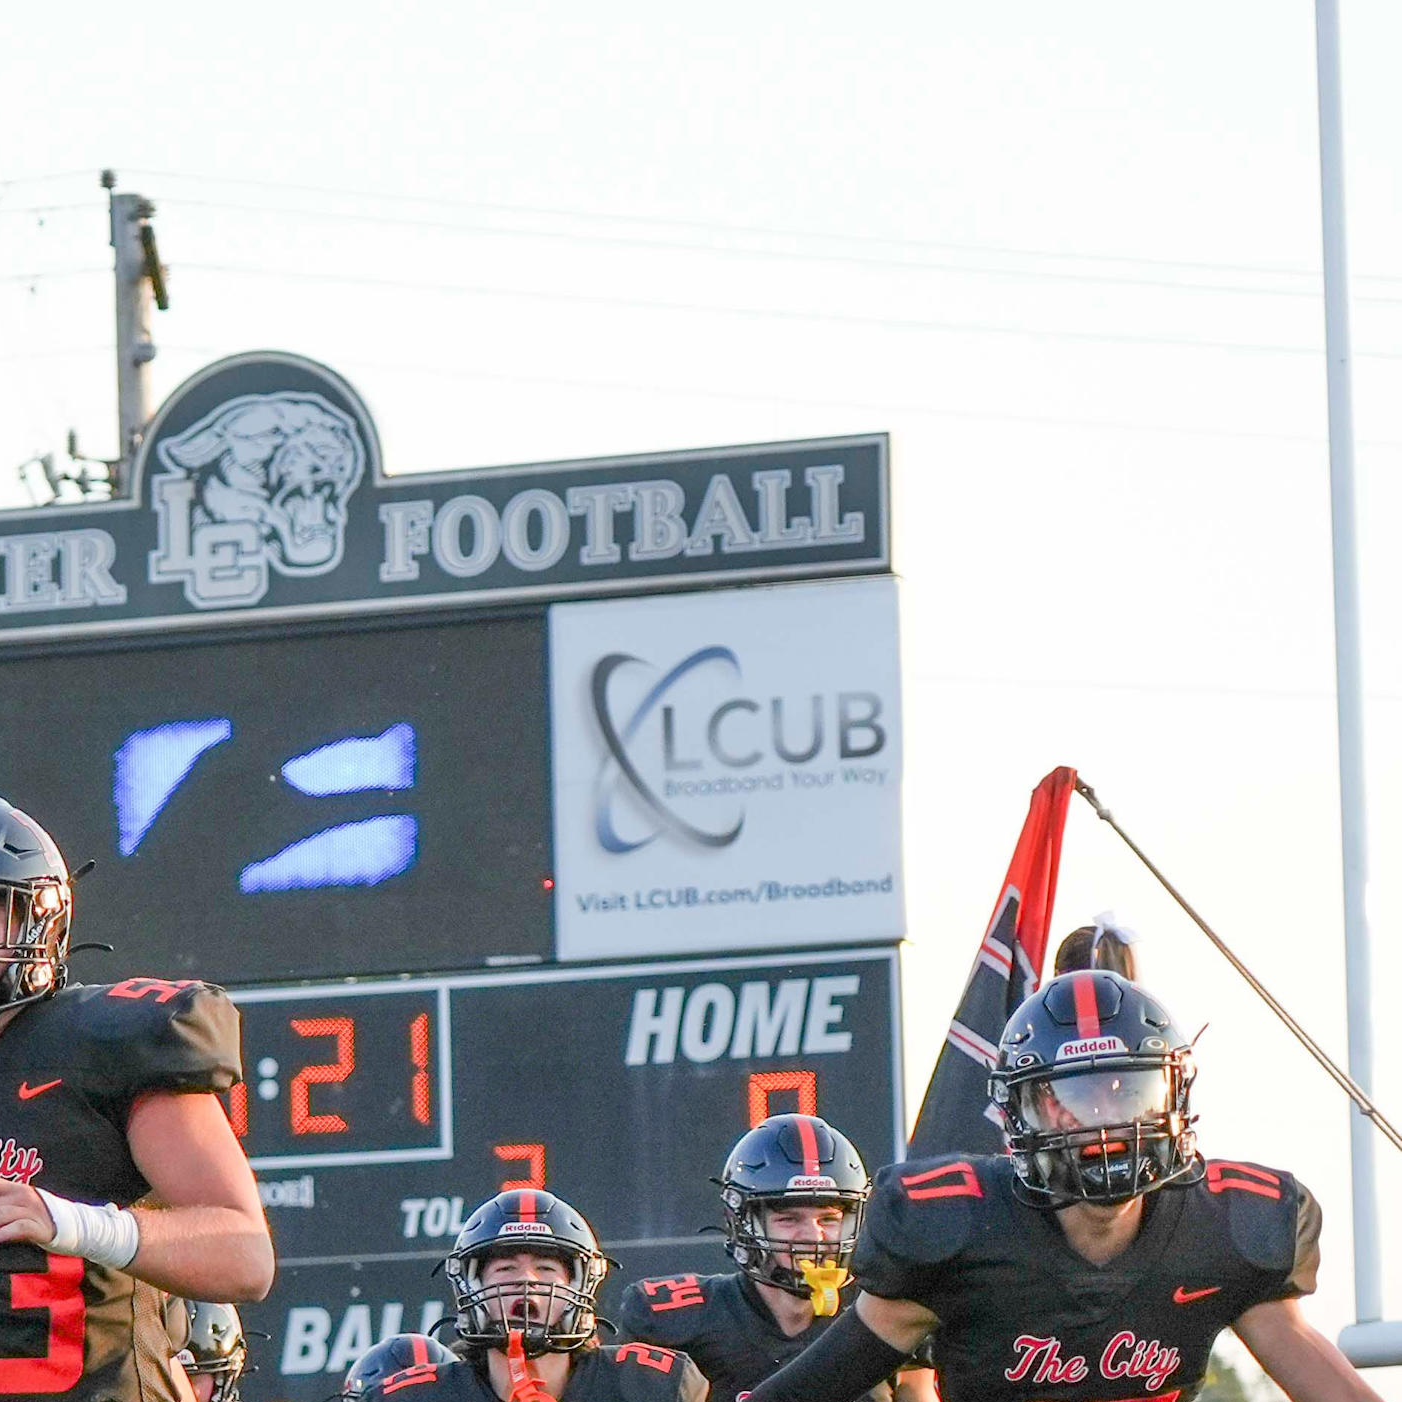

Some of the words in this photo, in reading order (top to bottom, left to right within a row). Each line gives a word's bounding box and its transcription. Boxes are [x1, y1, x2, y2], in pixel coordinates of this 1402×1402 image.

[379, 464, 865, 582] FOOTBALL
[663, 691, 887, 770] LCUB
[664, 773, 784, 797] Broadband
[791, 770, 834, 788] Your
[841, 767, 887, 786] Way
[576, 893, 627, 913] Visit
[635, 874, 893, 910] LCUB.com/Broadband
[624, 975, 861, 1067] HOME
[1063, 1039, 1117, 1056] Riddell
[230, 1013, 431, 1137] :21
[794, 1178, 831, 1188] Riddell
[401, 1198, 467, 1238] TOL
[505, 1223, 546, 1234] Riddell
[1005, 1333, 1089, 1385] The
[1100, 1331, 1181, 1391] City
